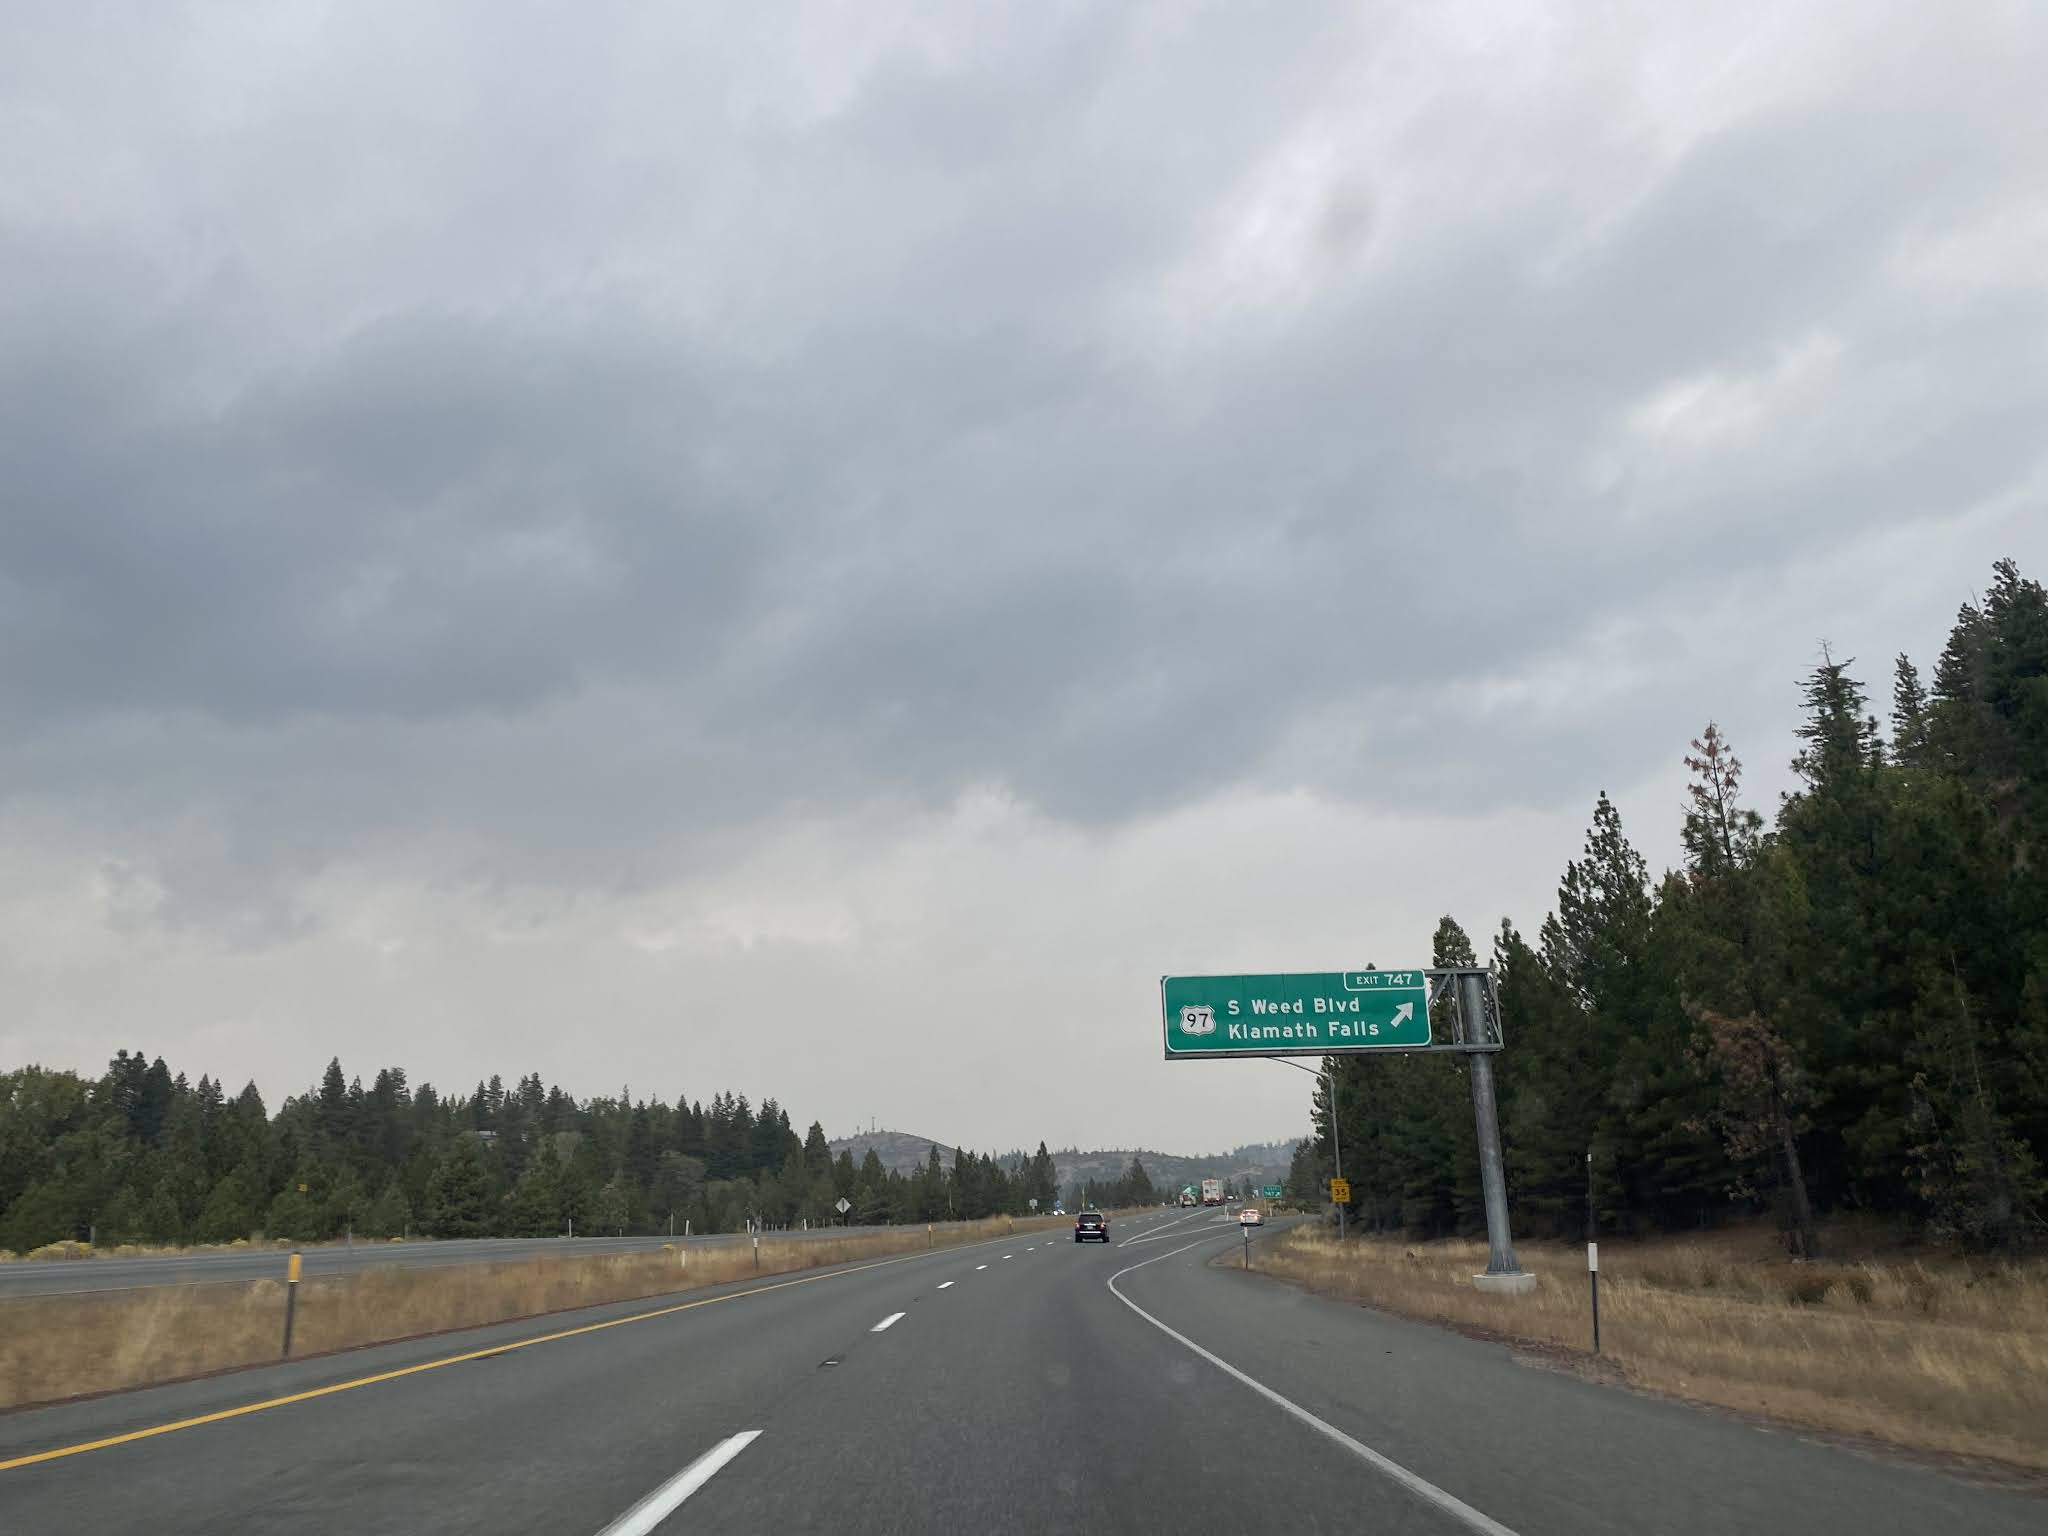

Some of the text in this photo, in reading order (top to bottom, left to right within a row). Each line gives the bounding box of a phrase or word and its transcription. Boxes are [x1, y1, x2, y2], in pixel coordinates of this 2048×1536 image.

[1356, 973, 1413, 986] EXIT 747
[1227, 997, 1360, 1015] S Weed Blvd
[1187, 1013, 1208, 1028] 97
[1228, 1021, 1379, 1040] Klamath Falls
[1335, 1188, 1347, 1196] 35
